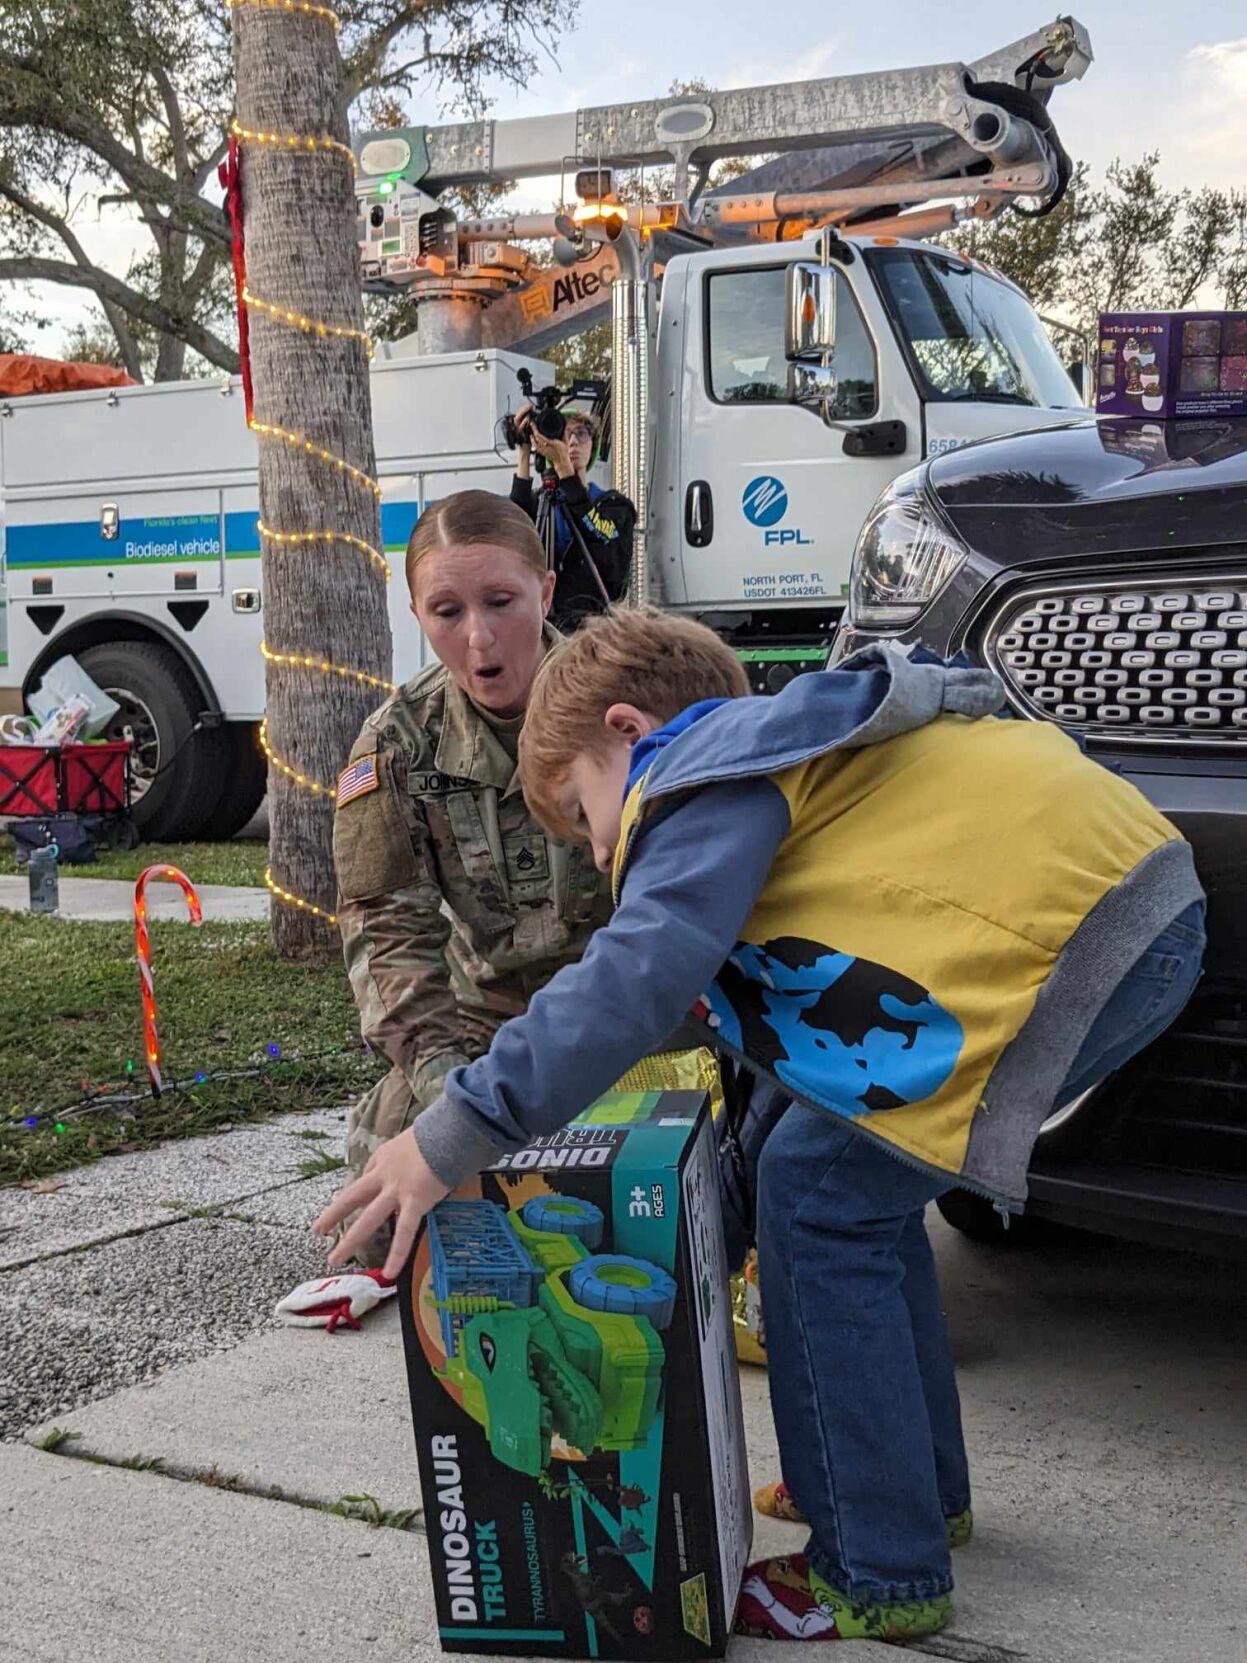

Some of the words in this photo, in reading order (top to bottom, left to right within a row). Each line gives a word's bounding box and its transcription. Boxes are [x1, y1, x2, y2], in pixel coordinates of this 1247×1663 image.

[553, 263, 616, 312] Altec
[125, 540, 177, 559] Biodiesel
[180, 538, 220, 556] vehicle
[743, 576, 776, 587] NORTH
[811, 573, 824, 583] FL
[744, 588, 777, 598] USDOT
[780, 586, 827, 596] 413426FL
[629, 1186, 650, 1217] 3+
[653, 1184, 663, 1218] AGES
[431, 1433, 478, 1623] DINOSAUR
[474, 1519, 506, 1622] TRUCK
[523, 1507, 546, 1622] TYRANNOSAURUS
